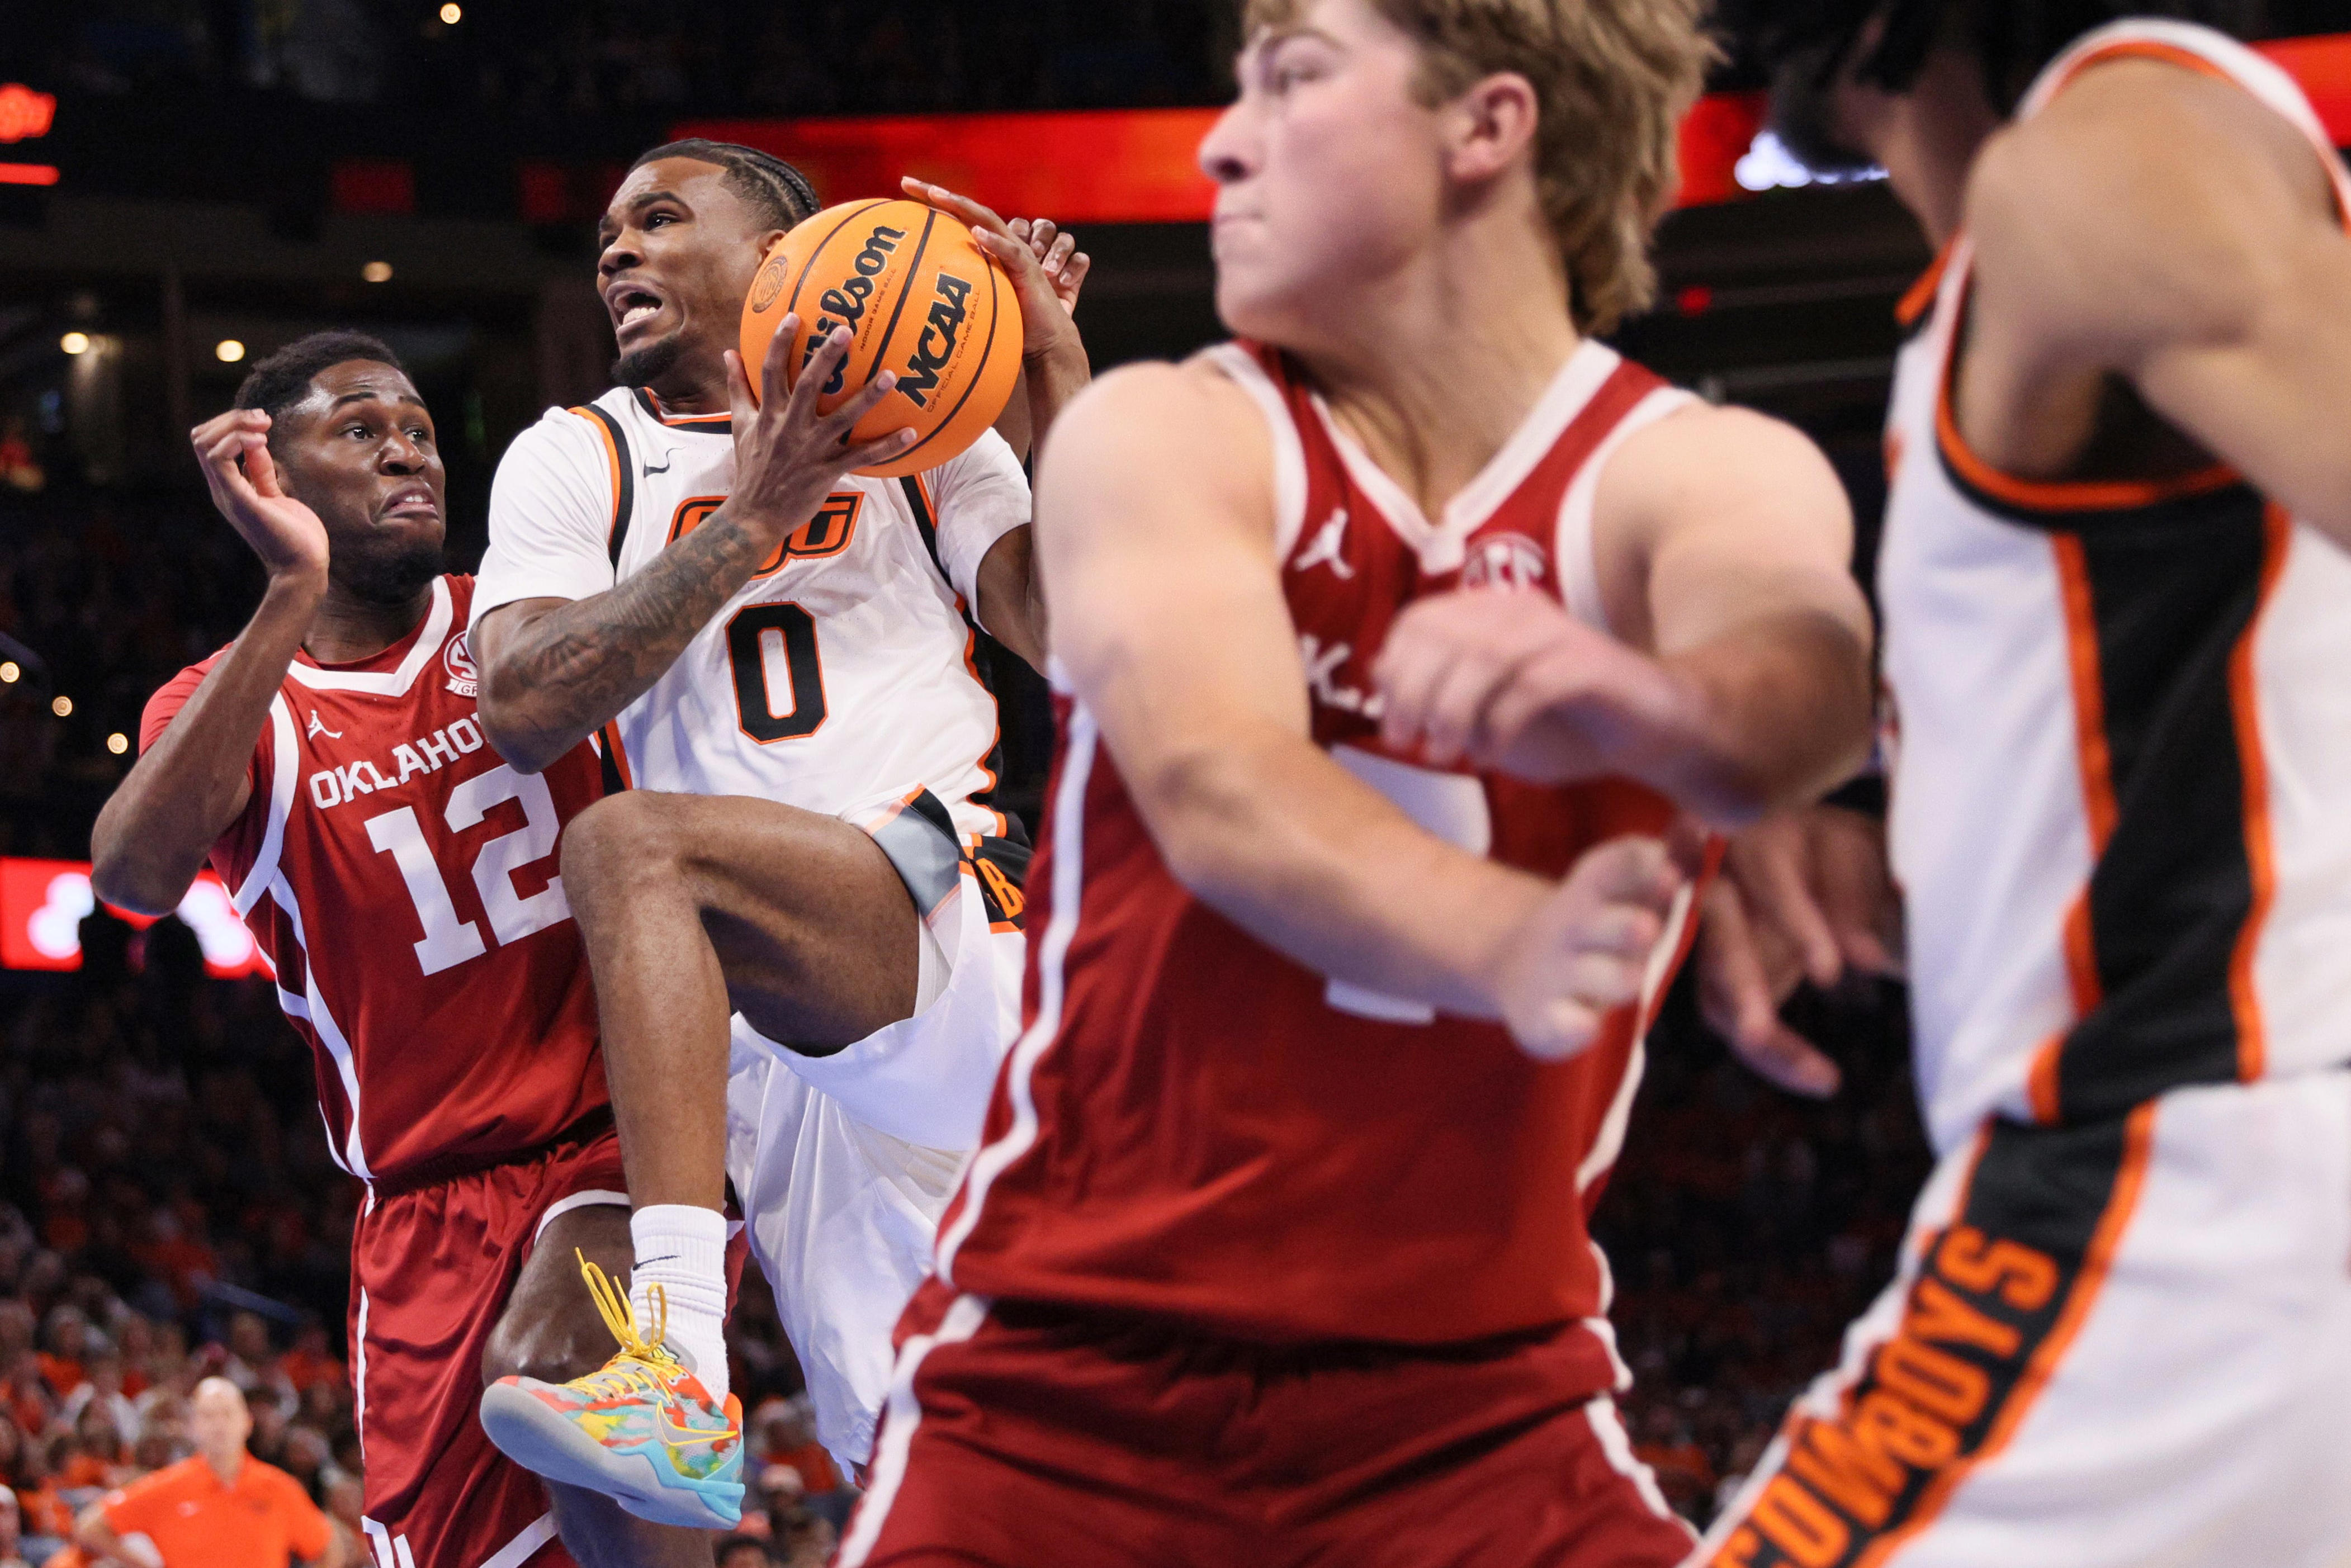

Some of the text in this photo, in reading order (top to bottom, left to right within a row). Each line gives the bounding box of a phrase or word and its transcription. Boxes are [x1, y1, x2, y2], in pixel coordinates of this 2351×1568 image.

[860, 318, 874, 352] INDOOR
[872, 290, 886, 315] GAME
[894, 272, 972, 409] NCAA
[927, 290, 981, 413] OFFICIAL GAME BALL
[725, 601, 829, 745] 0
[309, 712, 489, 809] OKLAHO
[364, 762, 574, 976] 12
